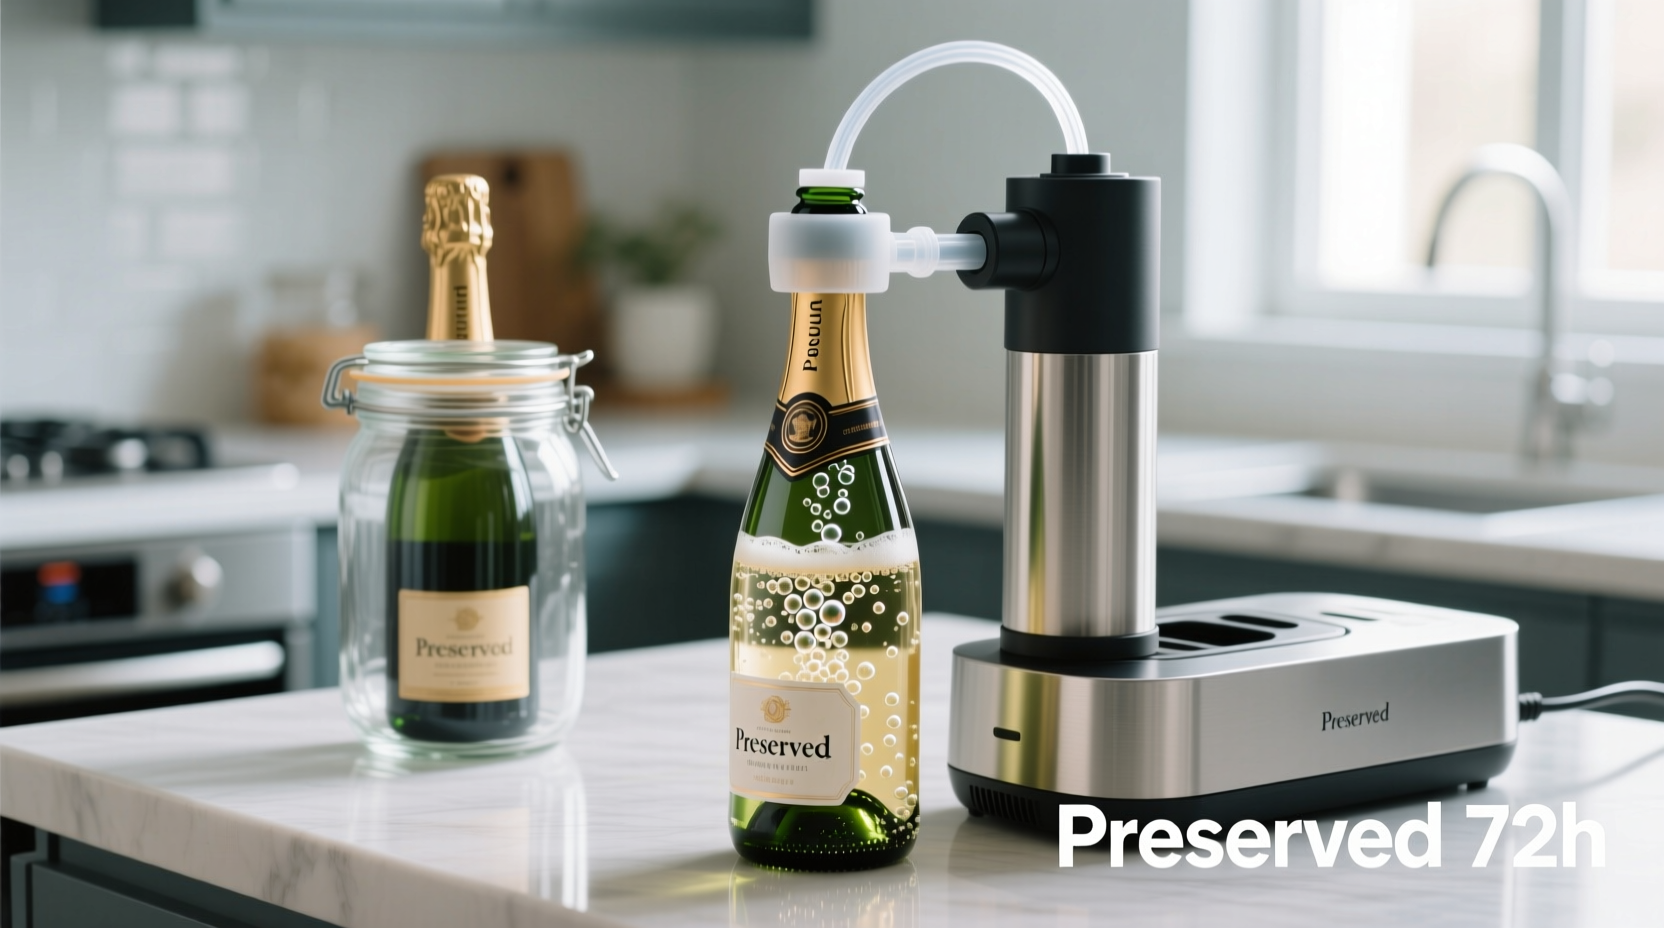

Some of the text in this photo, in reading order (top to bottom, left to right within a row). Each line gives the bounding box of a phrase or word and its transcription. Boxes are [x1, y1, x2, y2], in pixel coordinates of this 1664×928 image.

[415, 635, 514, 658] Preserved
[1321, 701, 1390, 732] Preserved
[735, 726, 832, 760] Preserved
